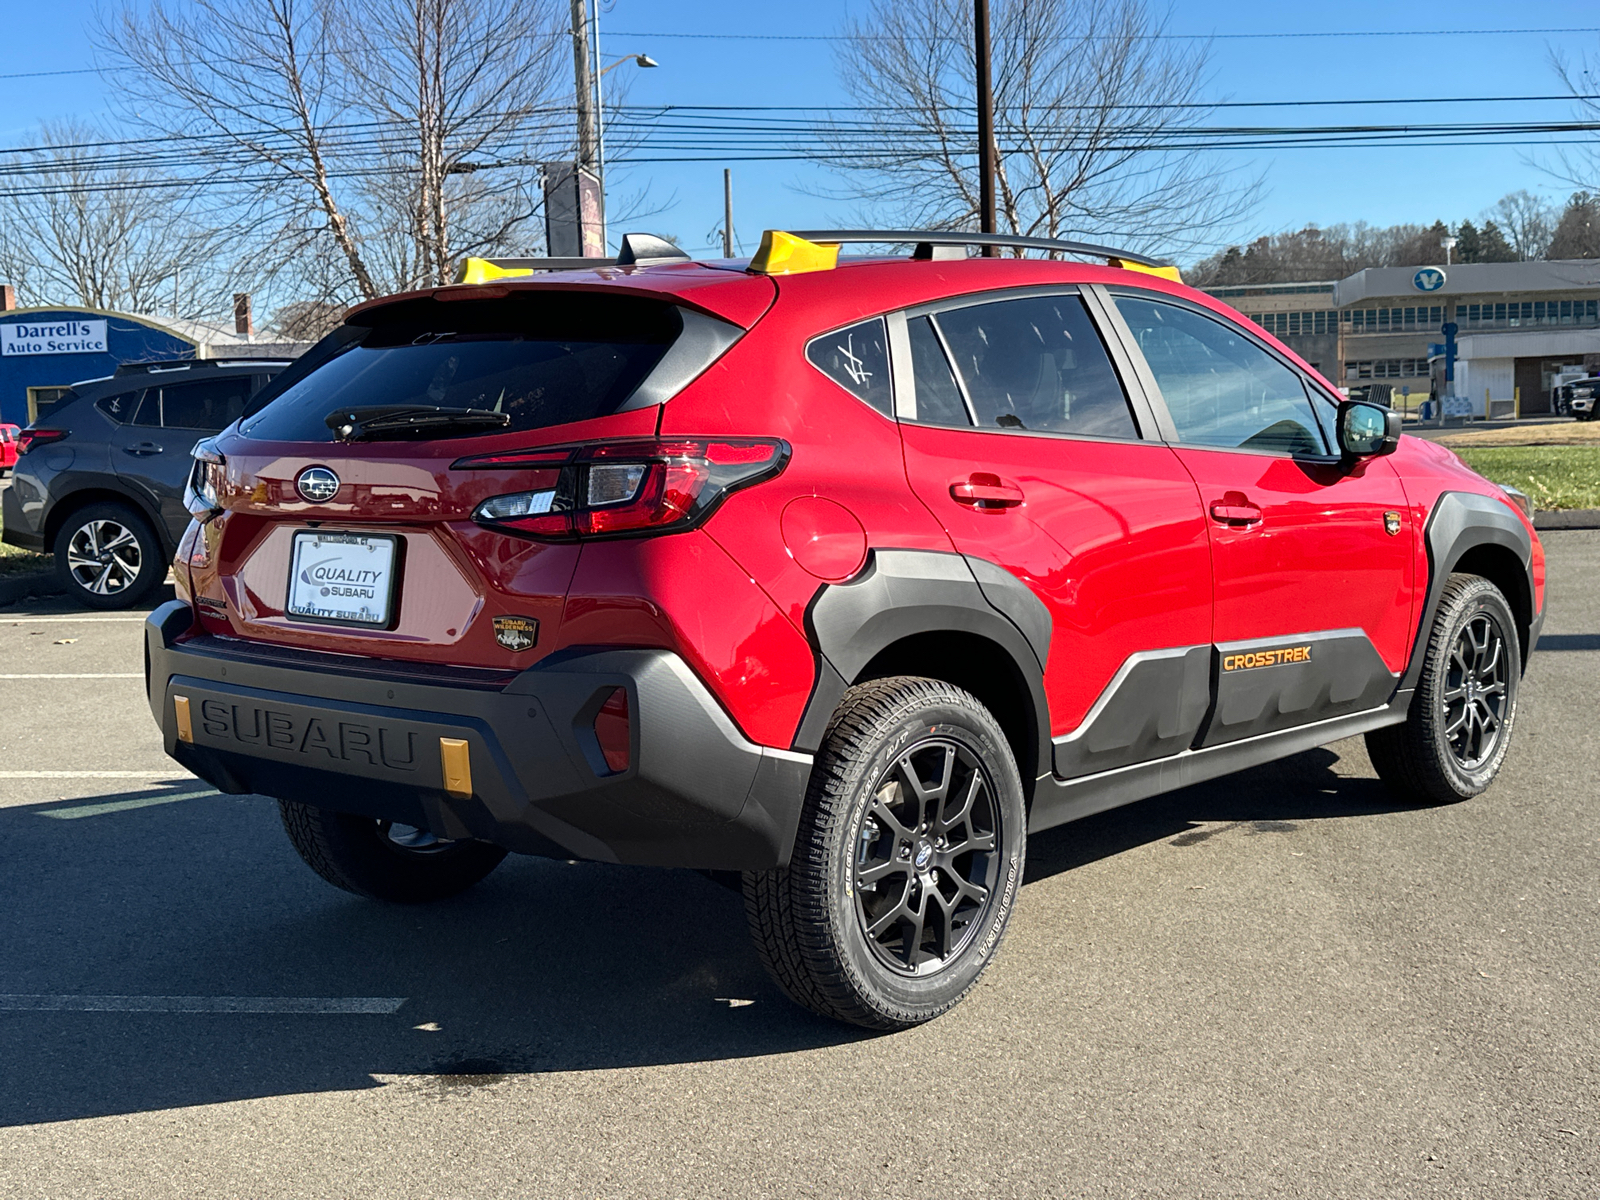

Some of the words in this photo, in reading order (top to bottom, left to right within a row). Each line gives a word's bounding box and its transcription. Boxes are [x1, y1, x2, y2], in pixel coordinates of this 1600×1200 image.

[16, 322, 91, 338] Darrell's
[7, 342, 42, 353] Auto
[47, 340, 103, 352] Service
[361, 538, 369, 546] CT
[315, 567, 382, 584] QUALITY
[331, 586, 375, 599] SUBARU
[291, 606, 333, 617] QUALITY
[336, 611, 379, 622] SUBARU
[1223, 646, 1311, 671] CROSSTREK
[201, 699, 418, 772] SUBARU
[979, 857, 1018, 957] YOKOHAMA
